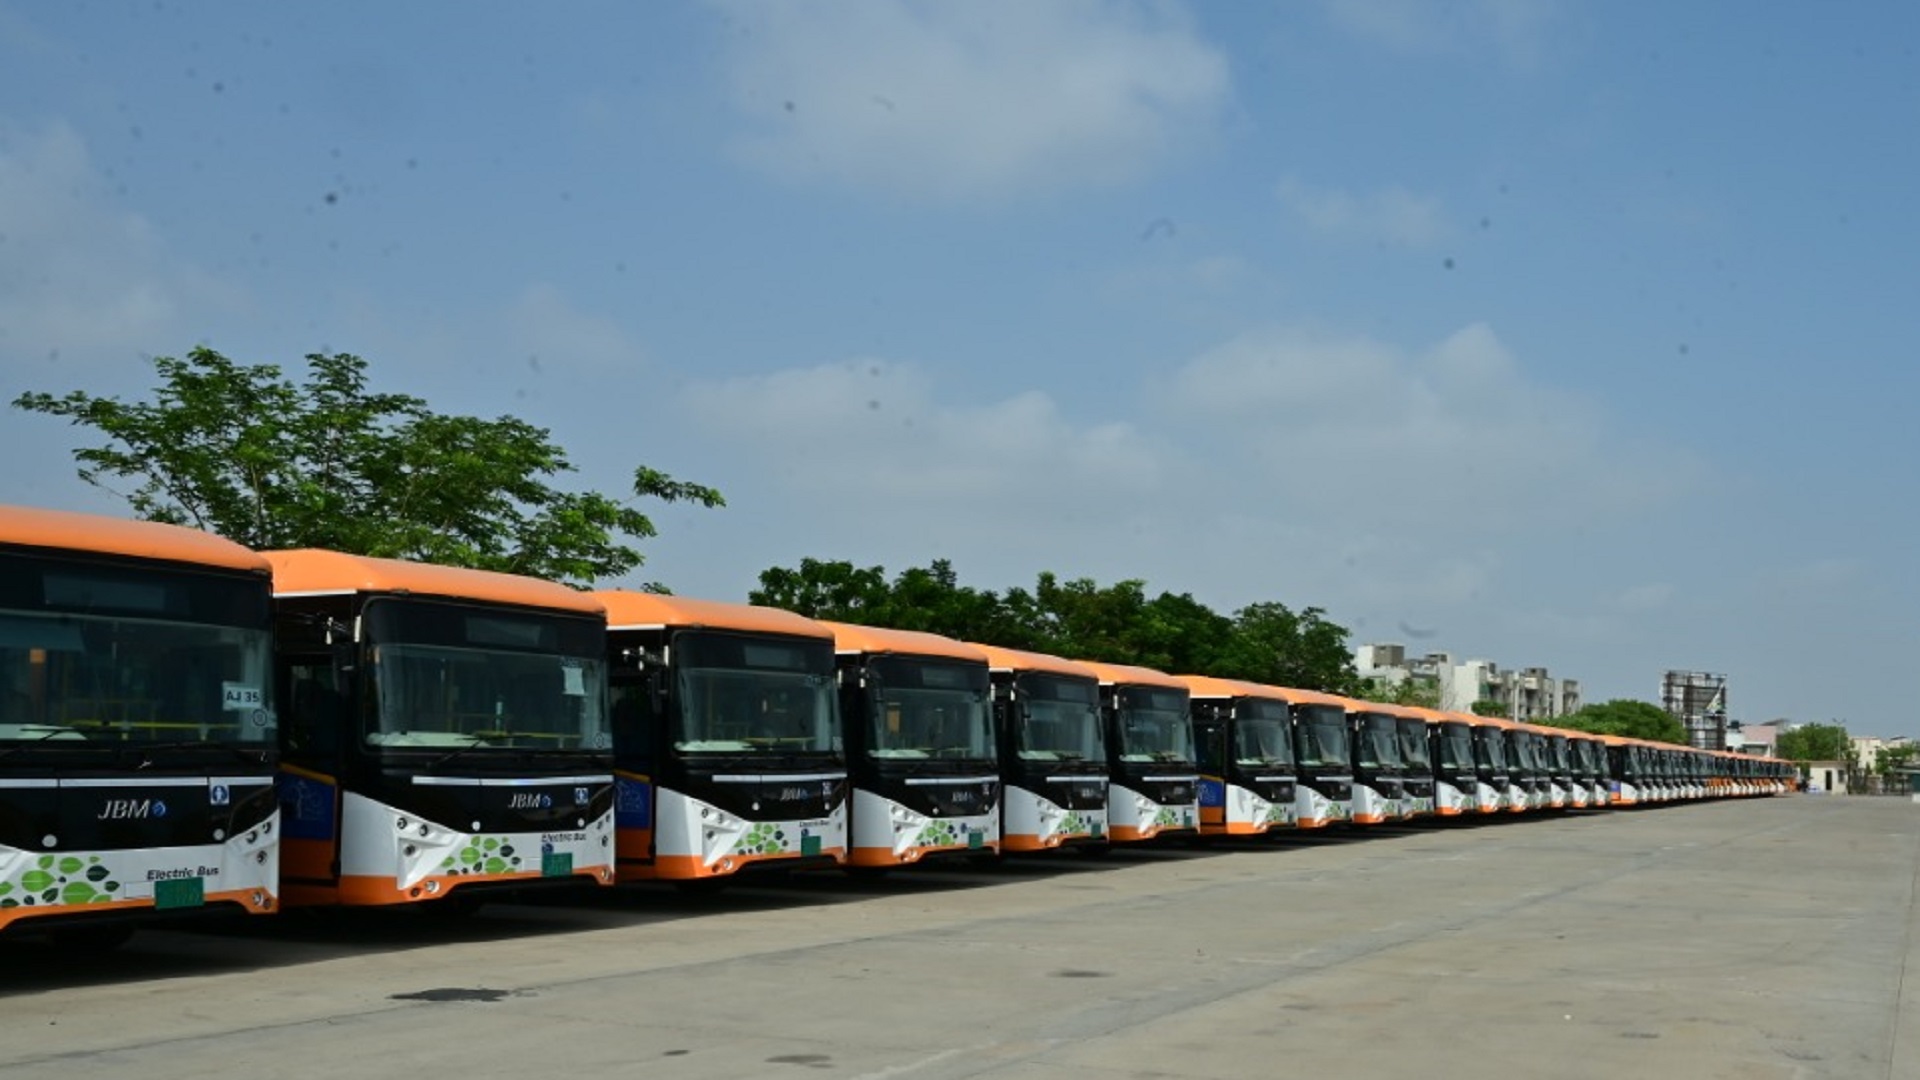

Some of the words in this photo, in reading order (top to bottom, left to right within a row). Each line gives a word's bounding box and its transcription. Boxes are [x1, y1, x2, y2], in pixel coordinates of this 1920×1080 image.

[226, 690, 242, 704] AJ
[244, 690, 260, 703] 35
[508, 793, 541, 809] JBM
[98, 799, 150, 820] JBM
[147, 867, 193, 881] Electric
[197, 865, 220, 877] Bus
